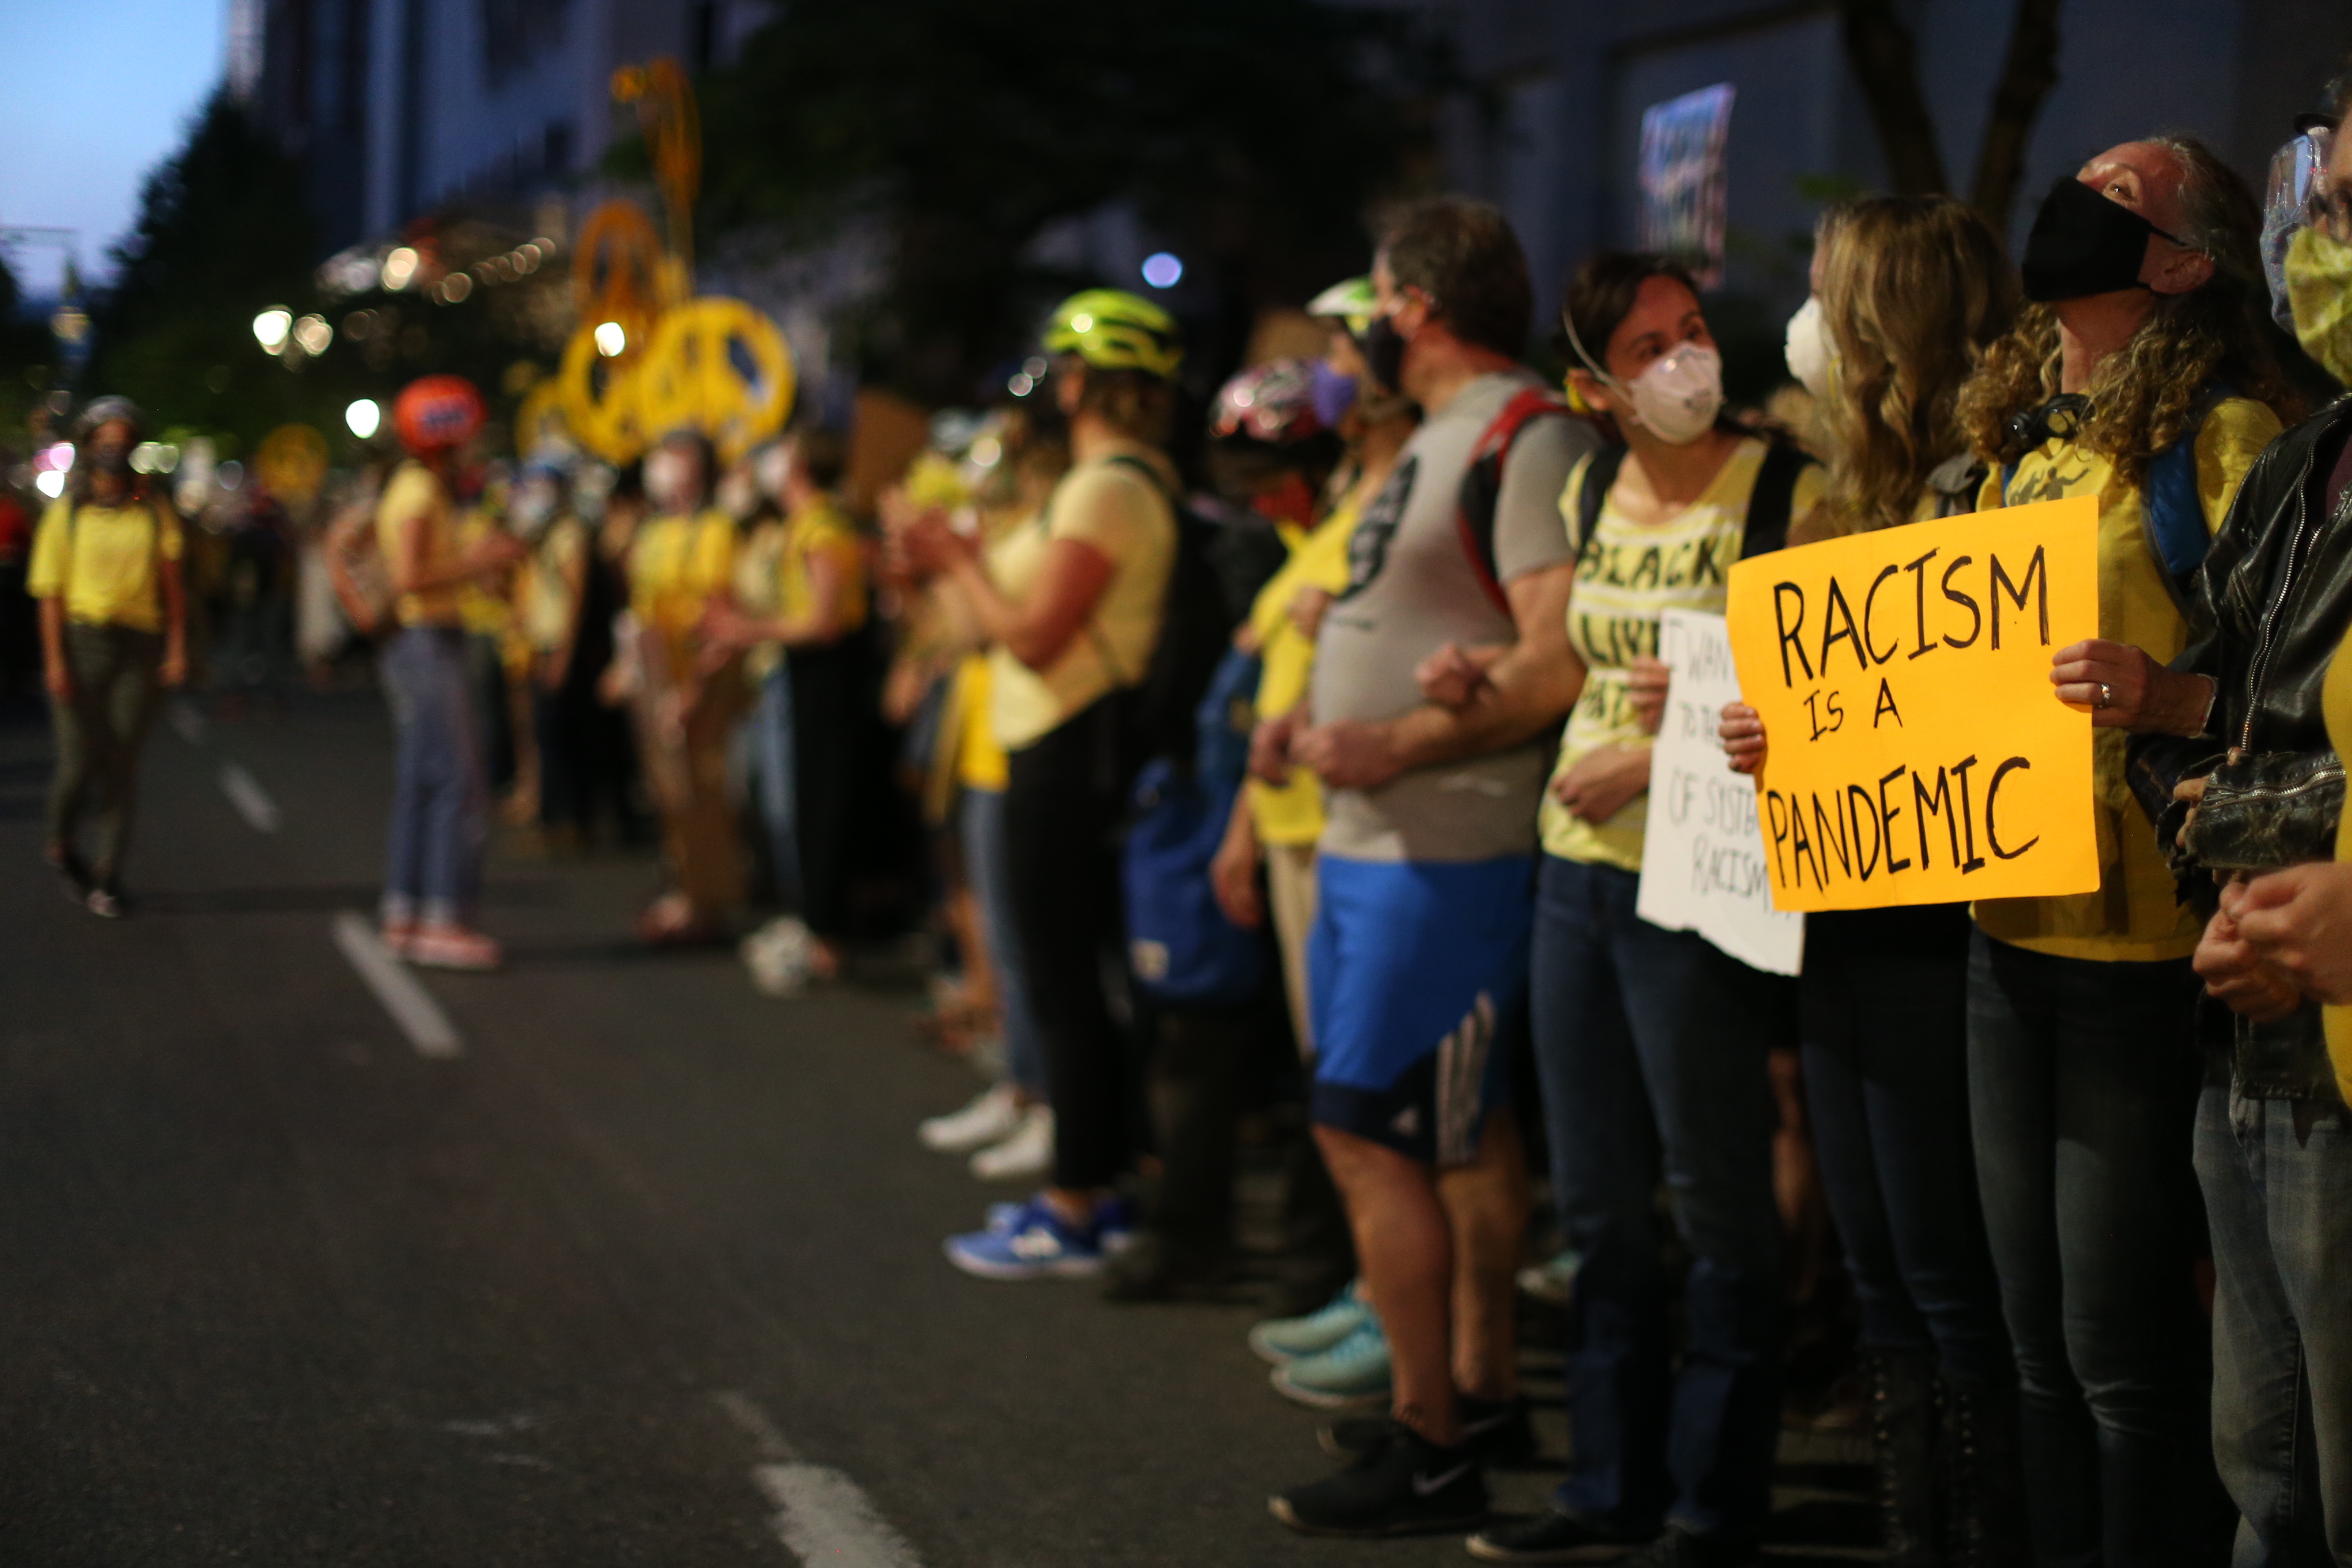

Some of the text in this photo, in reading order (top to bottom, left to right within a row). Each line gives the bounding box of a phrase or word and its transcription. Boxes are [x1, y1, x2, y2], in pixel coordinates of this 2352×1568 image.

[1580, 540, 1722, 589] BLACK
[1774, 544, 2050, 688] RACISM
[1803, 677, 1903, 742] IS A
[1669, 767, 1699, 826] OF
[1767, 754, 2040, 893] PANDEMIC
